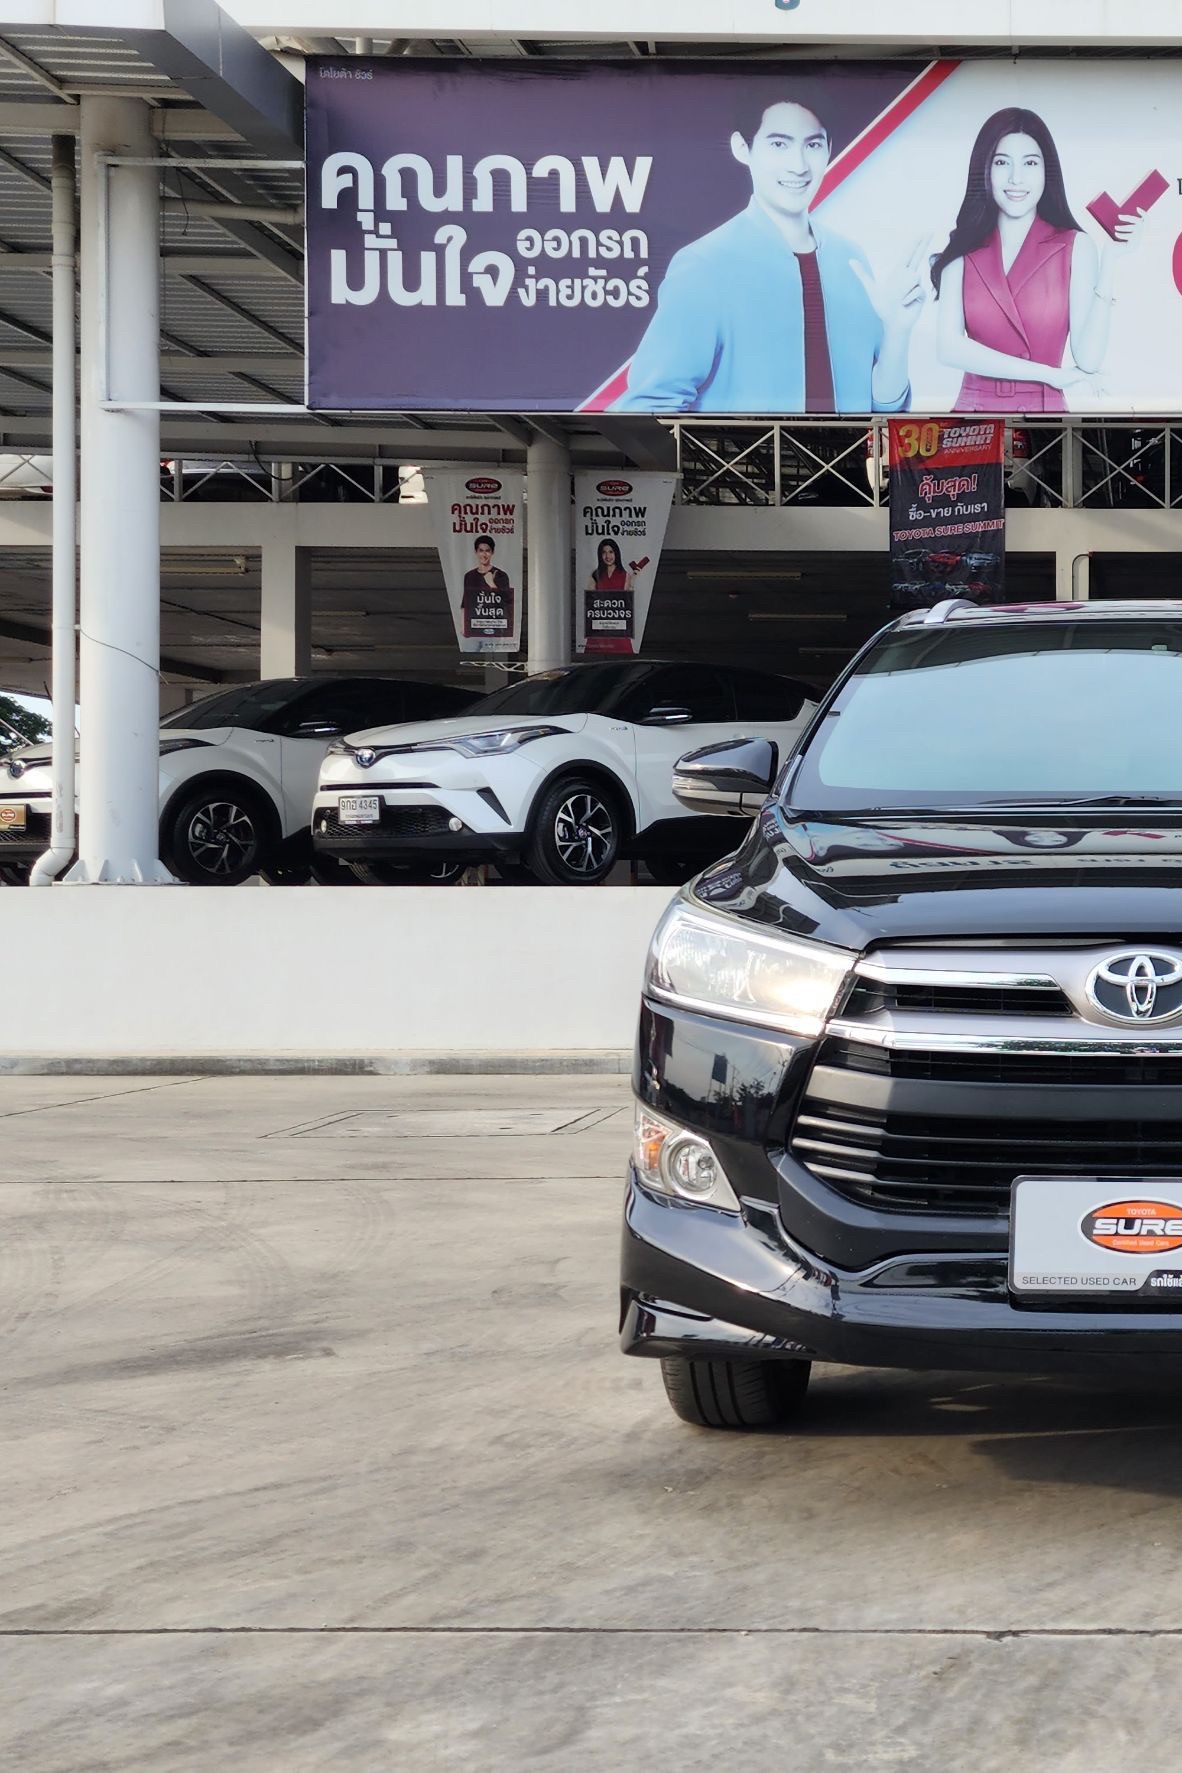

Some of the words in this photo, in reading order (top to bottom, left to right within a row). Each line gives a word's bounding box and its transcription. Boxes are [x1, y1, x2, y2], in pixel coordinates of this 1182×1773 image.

[321, 151, 653, 230] คุณภาพ
[516, 228, 649, 259] ออกรถ
[331, 222, 515, 307] มั่นใจ
[517, 265, 650, 307] ง่ายชัวร์
[942, 424, 994, 438] TOYOTA
[899, 423, 940, 457] 30
[942, 434, 993, 448] SUMMIT
[919, 474, 977, 503] คุ้มสุด!
[451, 503, 516, 518] คุณภาพ
[583, 506, 647, 521] คุณภาพ
[955, 502, 988, 516] กับเรา
[453, 516, 489, 533] มั่นใจ
[585, 519, 620, 536] มั่นใจ
[893, 528, 935, 541] TOYOTA
[935, 523, 963, 536] SURE
[964, 519, 1004, 532] SUMMIT
[477, 591, 501, 604] มั่นใจ
[587, 610, 632, 618] ครบวงจร
[359, 800, 377, 810] 4345
[1022, 1276, 1078, 1286] SELECTED
[1081, 1276, 1109, 1286] USED
[1113, 1277, 1136, 1286] CAR
